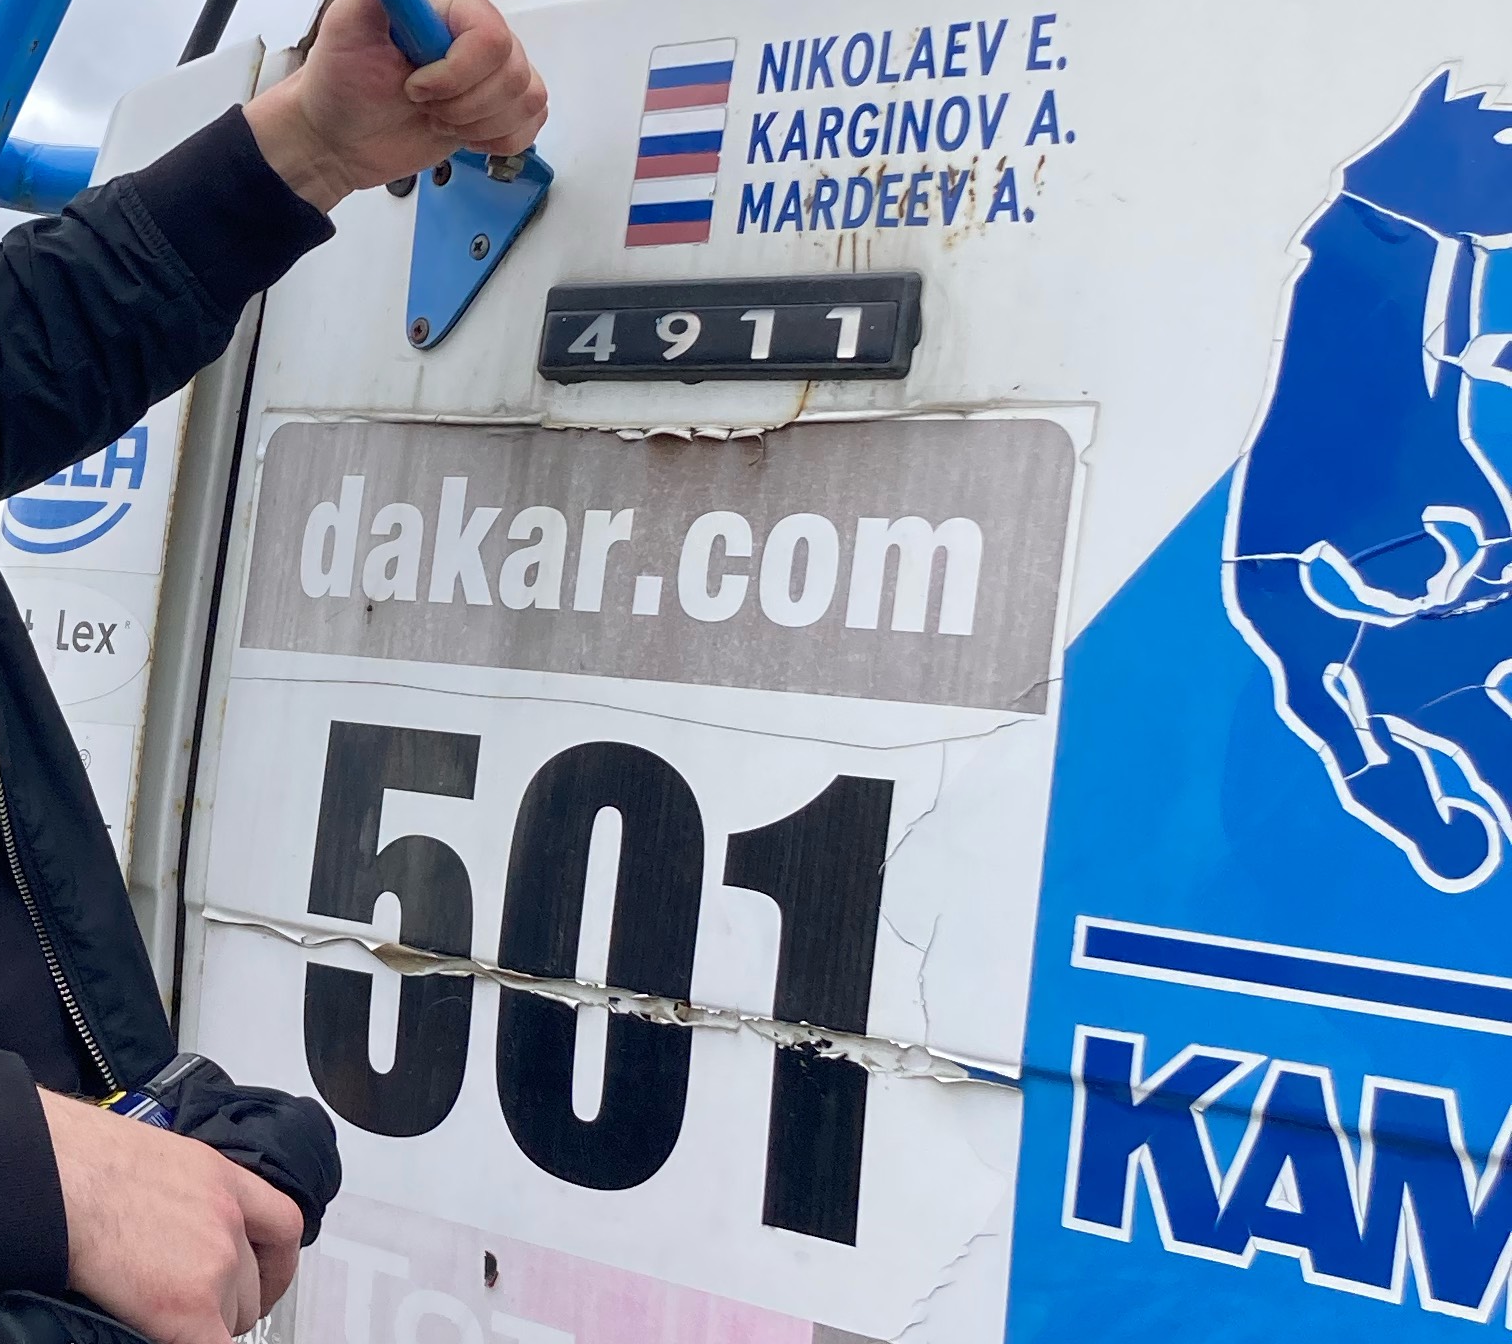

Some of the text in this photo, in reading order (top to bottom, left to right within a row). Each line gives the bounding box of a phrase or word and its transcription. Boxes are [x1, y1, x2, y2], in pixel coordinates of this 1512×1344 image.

[756, 13, 1068, 94] NIKOLAEV E.
[746, 89, 1077, 165] KARGINOV A.
[736, 166, 1036, 234] MARDEEV A.
[567, 306, 863, 362] 4911
[299, 475, 984, 635] dakar.com
[56, 609, 118, 654] Lex
[303, 720, 895, 1247] 501
